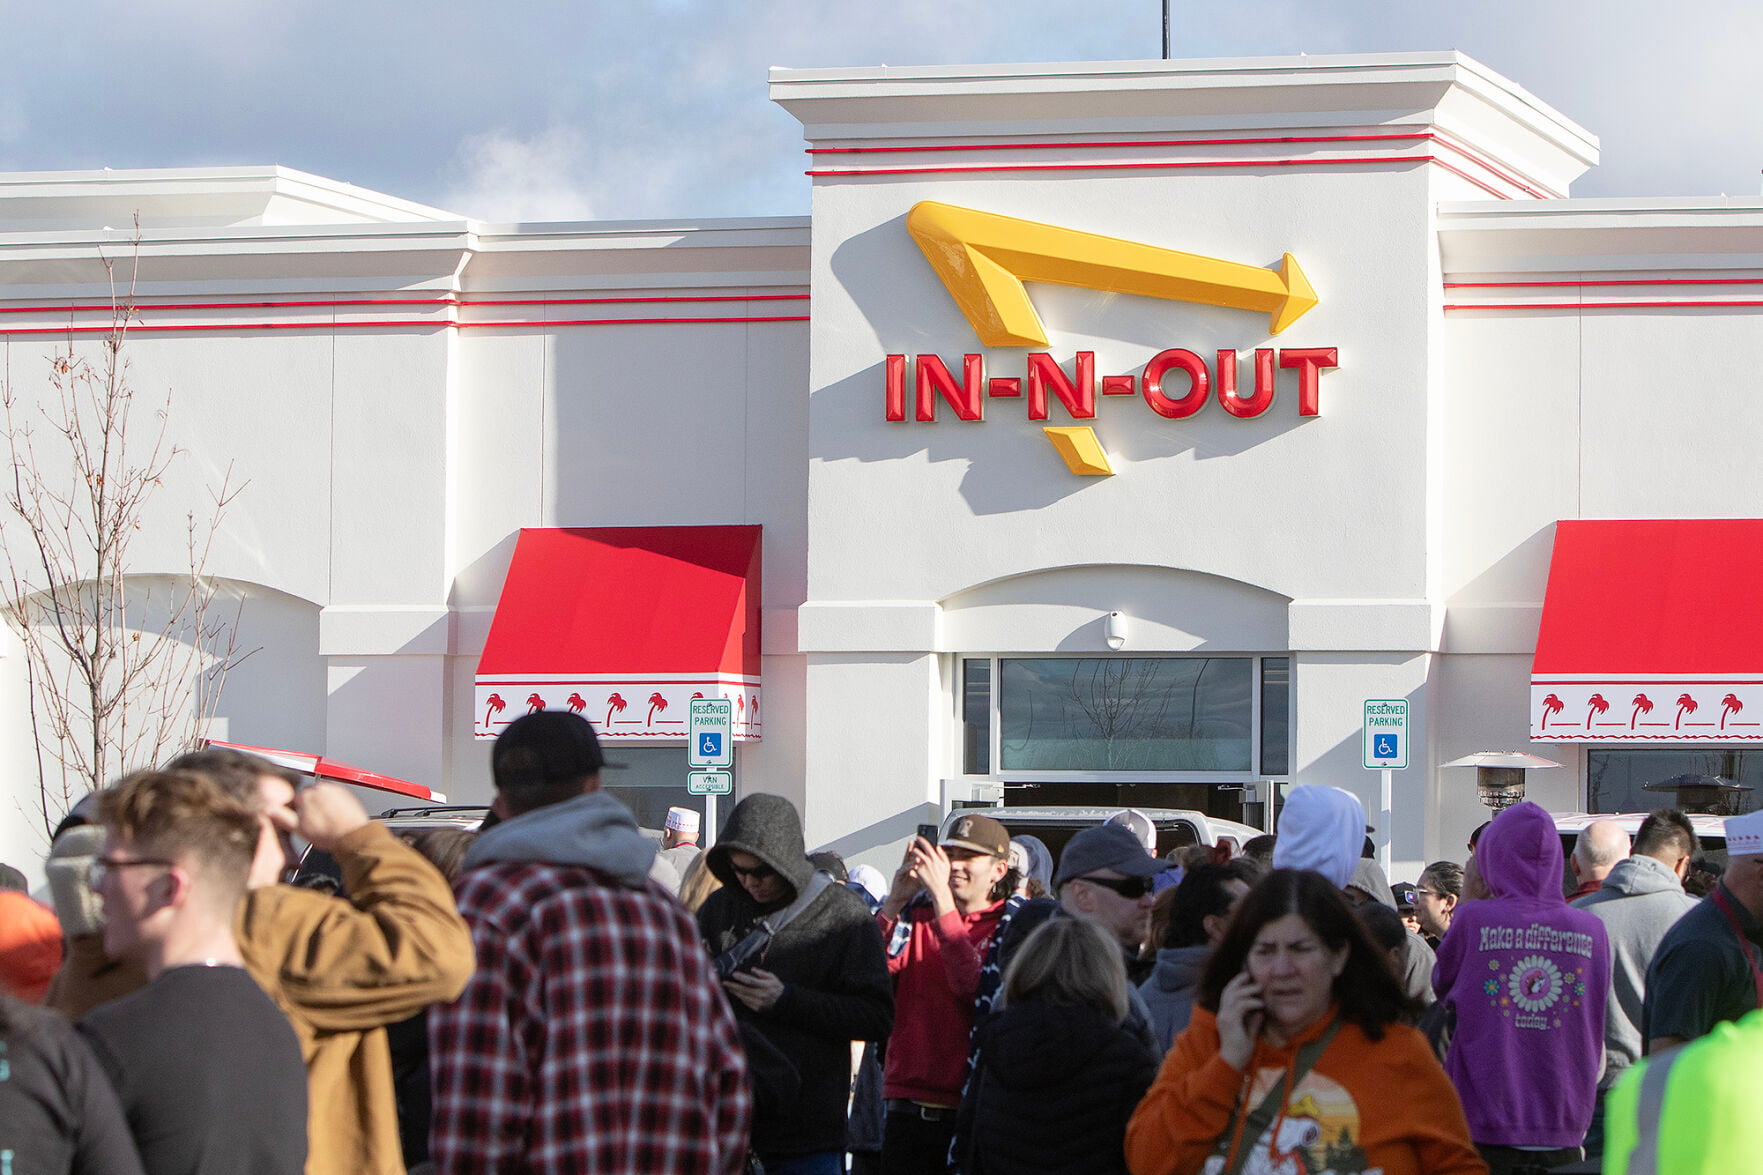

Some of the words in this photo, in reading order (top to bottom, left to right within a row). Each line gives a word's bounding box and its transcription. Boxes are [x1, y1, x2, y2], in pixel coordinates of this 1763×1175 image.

[885, 346, 1339, 422] IN-N-OUT
[692, 705, 728, 714] RESERVED
[1366, 705, 1405, 714] RESERVED
[694, 716, 727, 726] PARKING
[1368, 717, 1403, 726] PARKING
[1479, 926, 1514, 951] Make
[1515, 928, 1524, 950] a
[1525, 923, 1593, 959] difference
